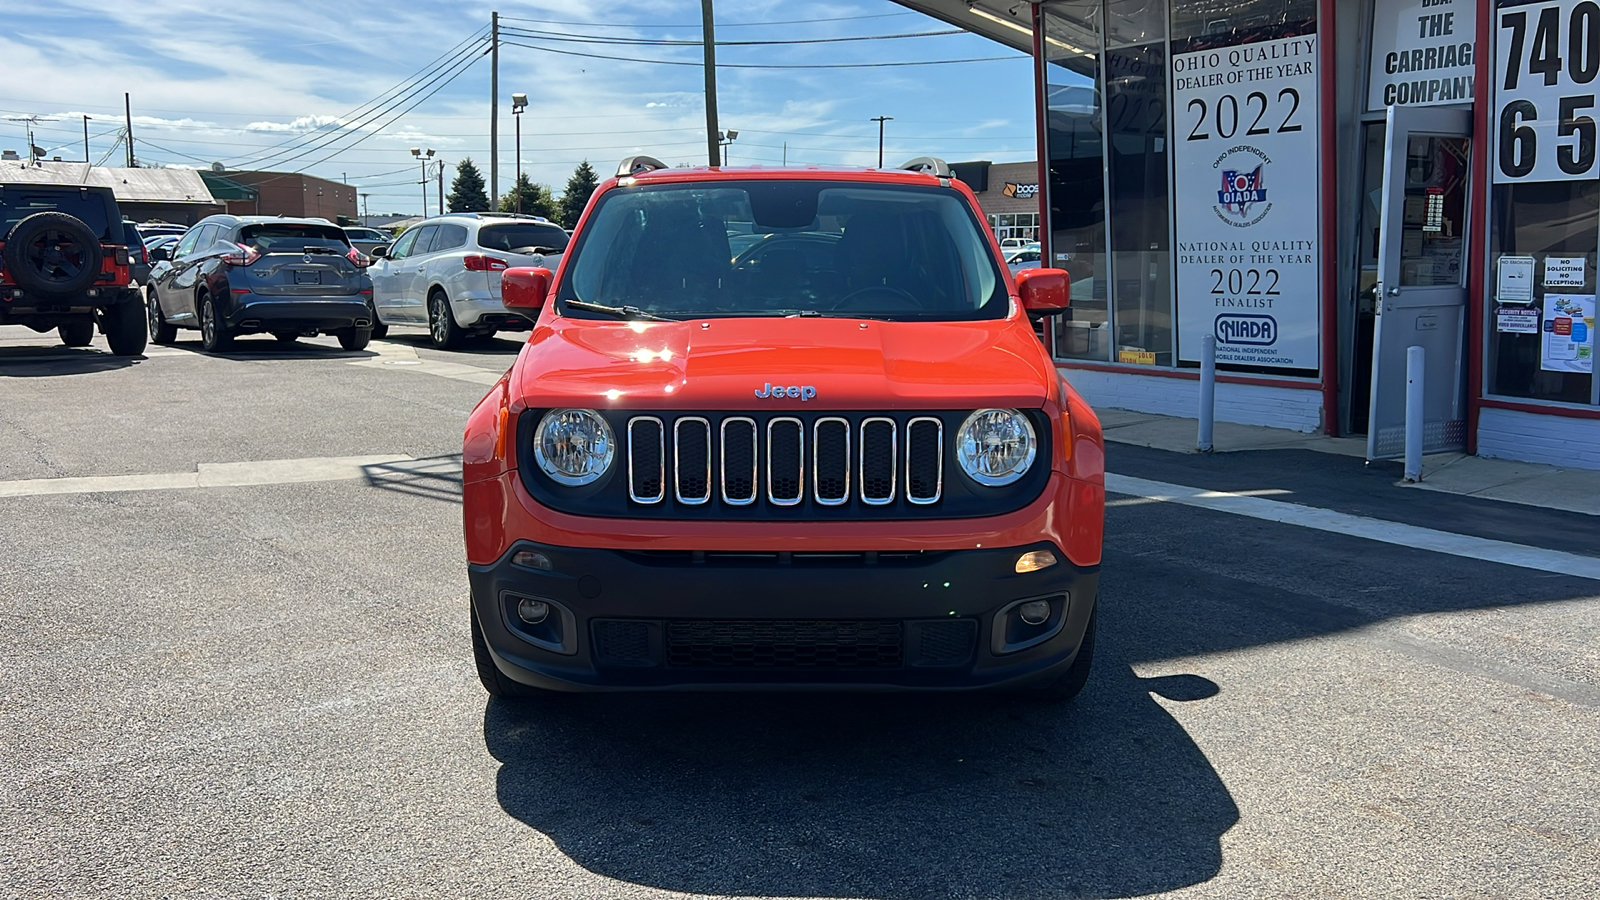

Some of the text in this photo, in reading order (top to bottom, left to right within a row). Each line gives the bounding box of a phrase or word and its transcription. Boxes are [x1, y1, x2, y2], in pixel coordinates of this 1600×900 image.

[1418, 12, 1454, 38] THE
[1174, 39, 1315, 73] OHIO QUALITY
[1501, 1, 1600, 91] 740
[1176, 61, 1313, 91] DEALER OF THE YEAR
[1383, 75, 1475, 106] COMPANY
[1186, 87, 1302, 141] 2022
[1212, 145, 1272, 169] OHIO INDEPENDENT
[1223, 190, 1259, 203] OIADA
[1179, 240, 1314, 253] NATIONAL QUALITY
[1180, 254, 1312, 264] DEALER OF THE YEAR
[1210, 268, 1281, 296] 2022
[1215, 298, 1274, 309] FINALIST
[1219, 320, 1272, 339] NIADA
[1241, 347, 1278, 355] INDEPENDENT
[1257, 356, 1294, 364] ASSOCIATION
[754, 382, 817, 402] Jeep
